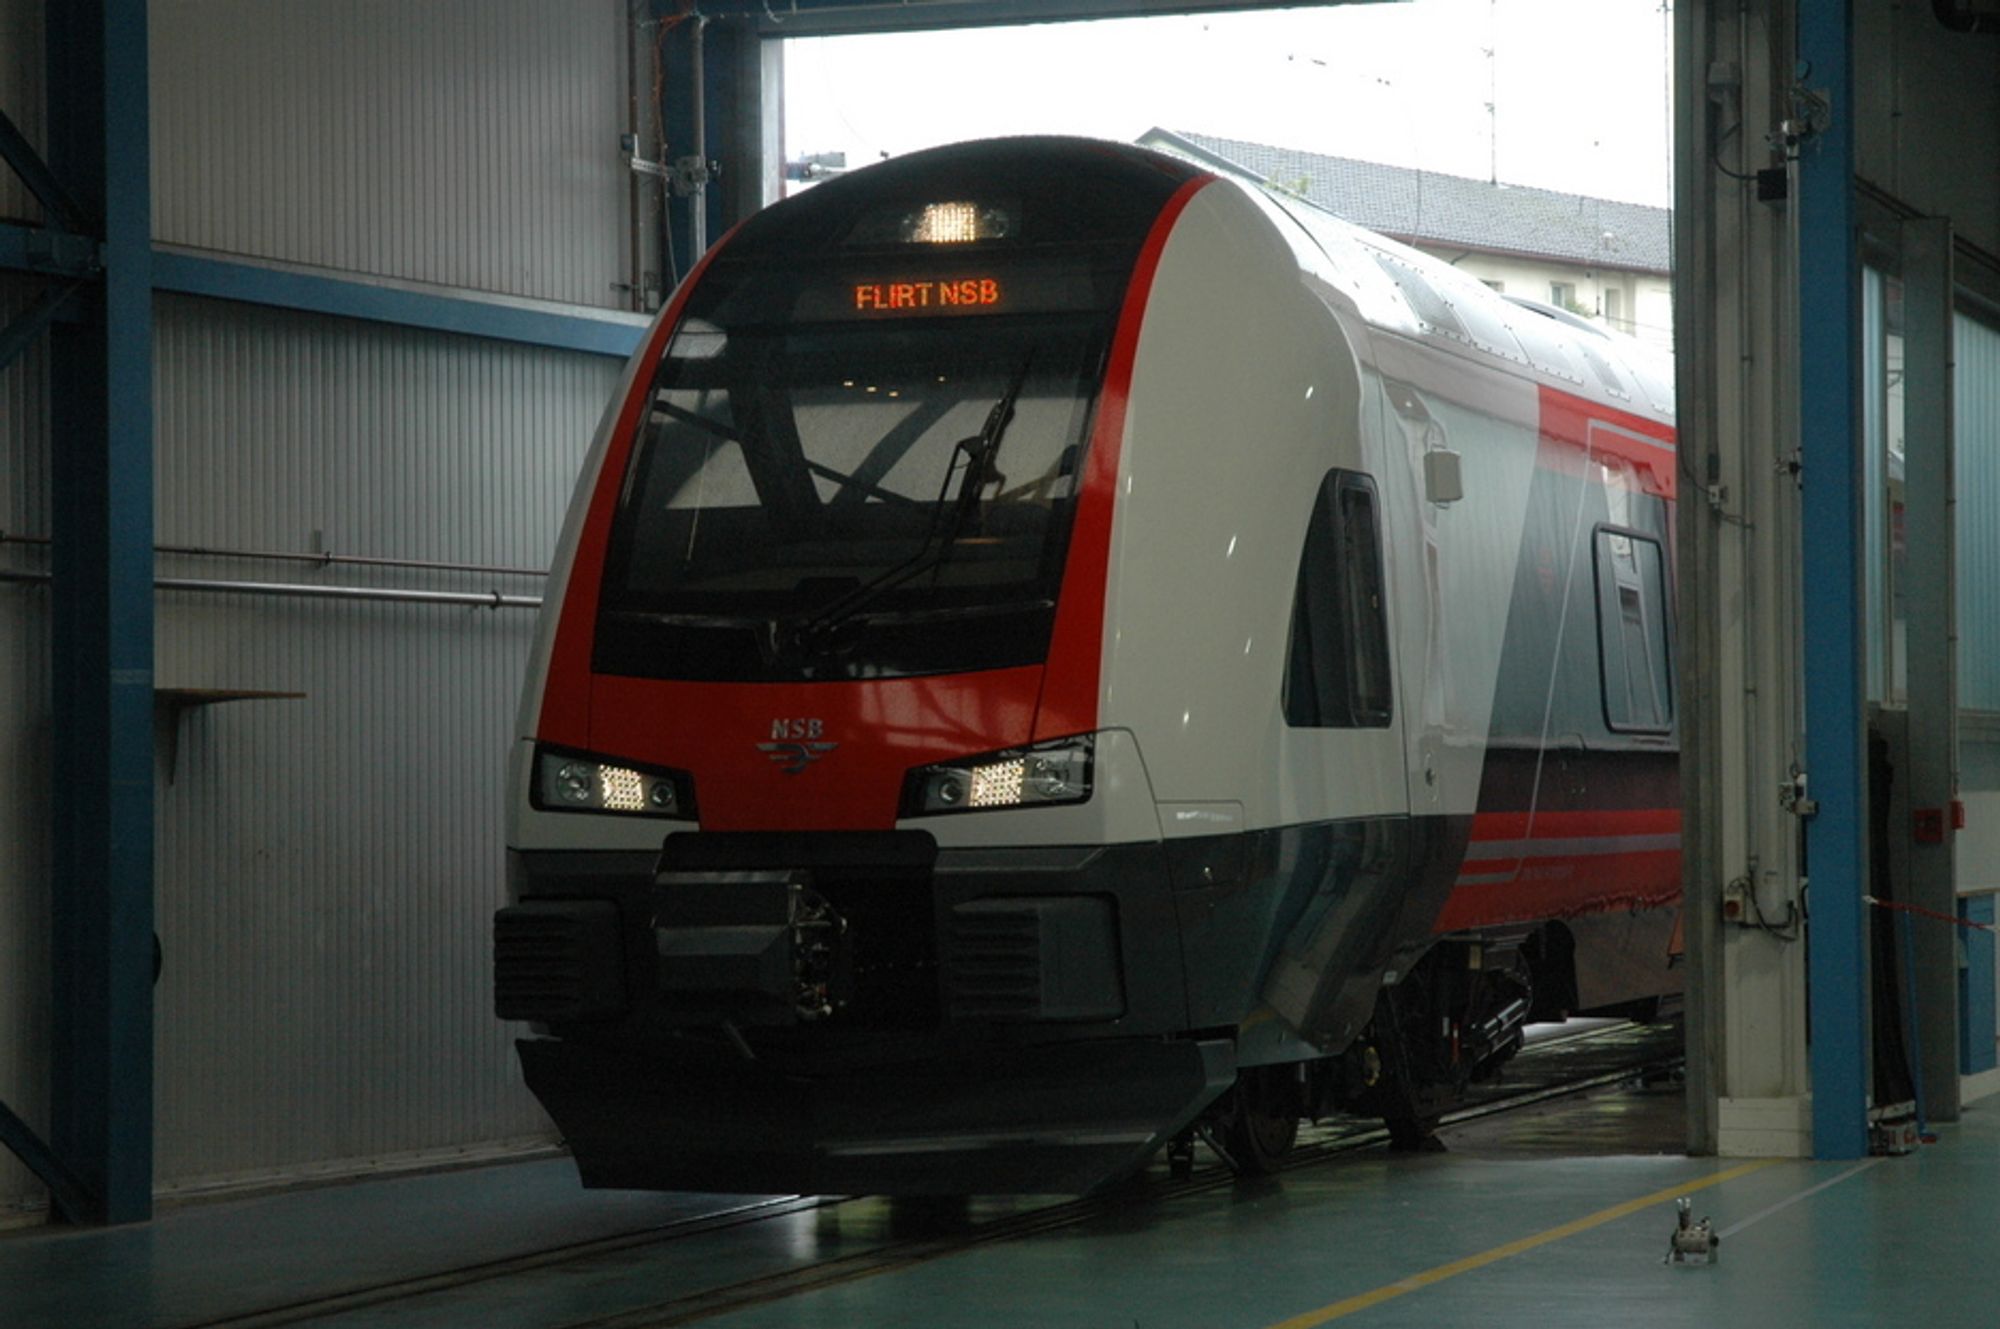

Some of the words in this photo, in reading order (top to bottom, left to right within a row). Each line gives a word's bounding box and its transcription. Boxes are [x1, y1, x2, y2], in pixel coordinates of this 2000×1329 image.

[856, 282, 933, 309] FLIRT
[939, 279, 999, 306] NSB
[771, 718, 824, 740] NSB
